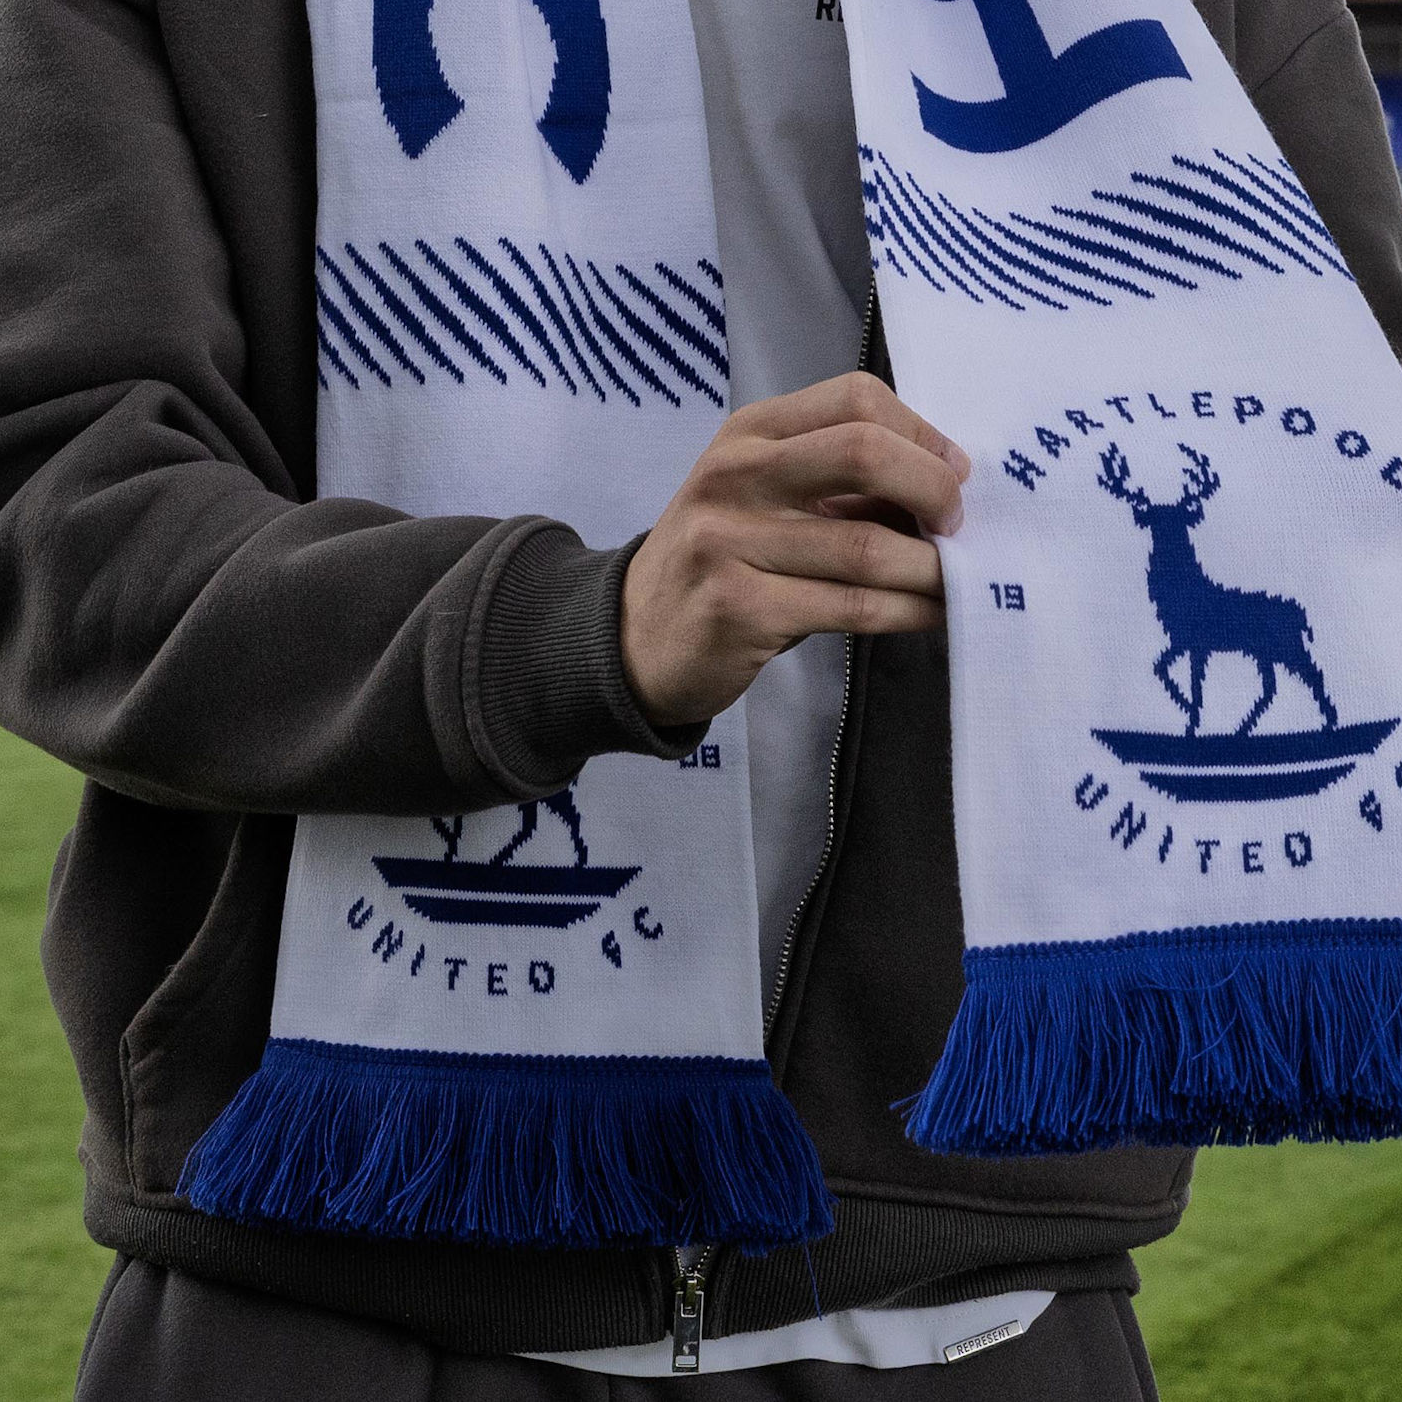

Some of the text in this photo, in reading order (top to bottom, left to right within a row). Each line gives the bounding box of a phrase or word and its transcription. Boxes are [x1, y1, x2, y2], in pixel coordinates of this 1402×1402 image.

[989, 582, 1027, 611] 19
[1075, 773, 1313, 874] UNITED
[347, 897, 664, 997] UNITED FC
[956, 1326, 1012, 1356] REPRESENT
